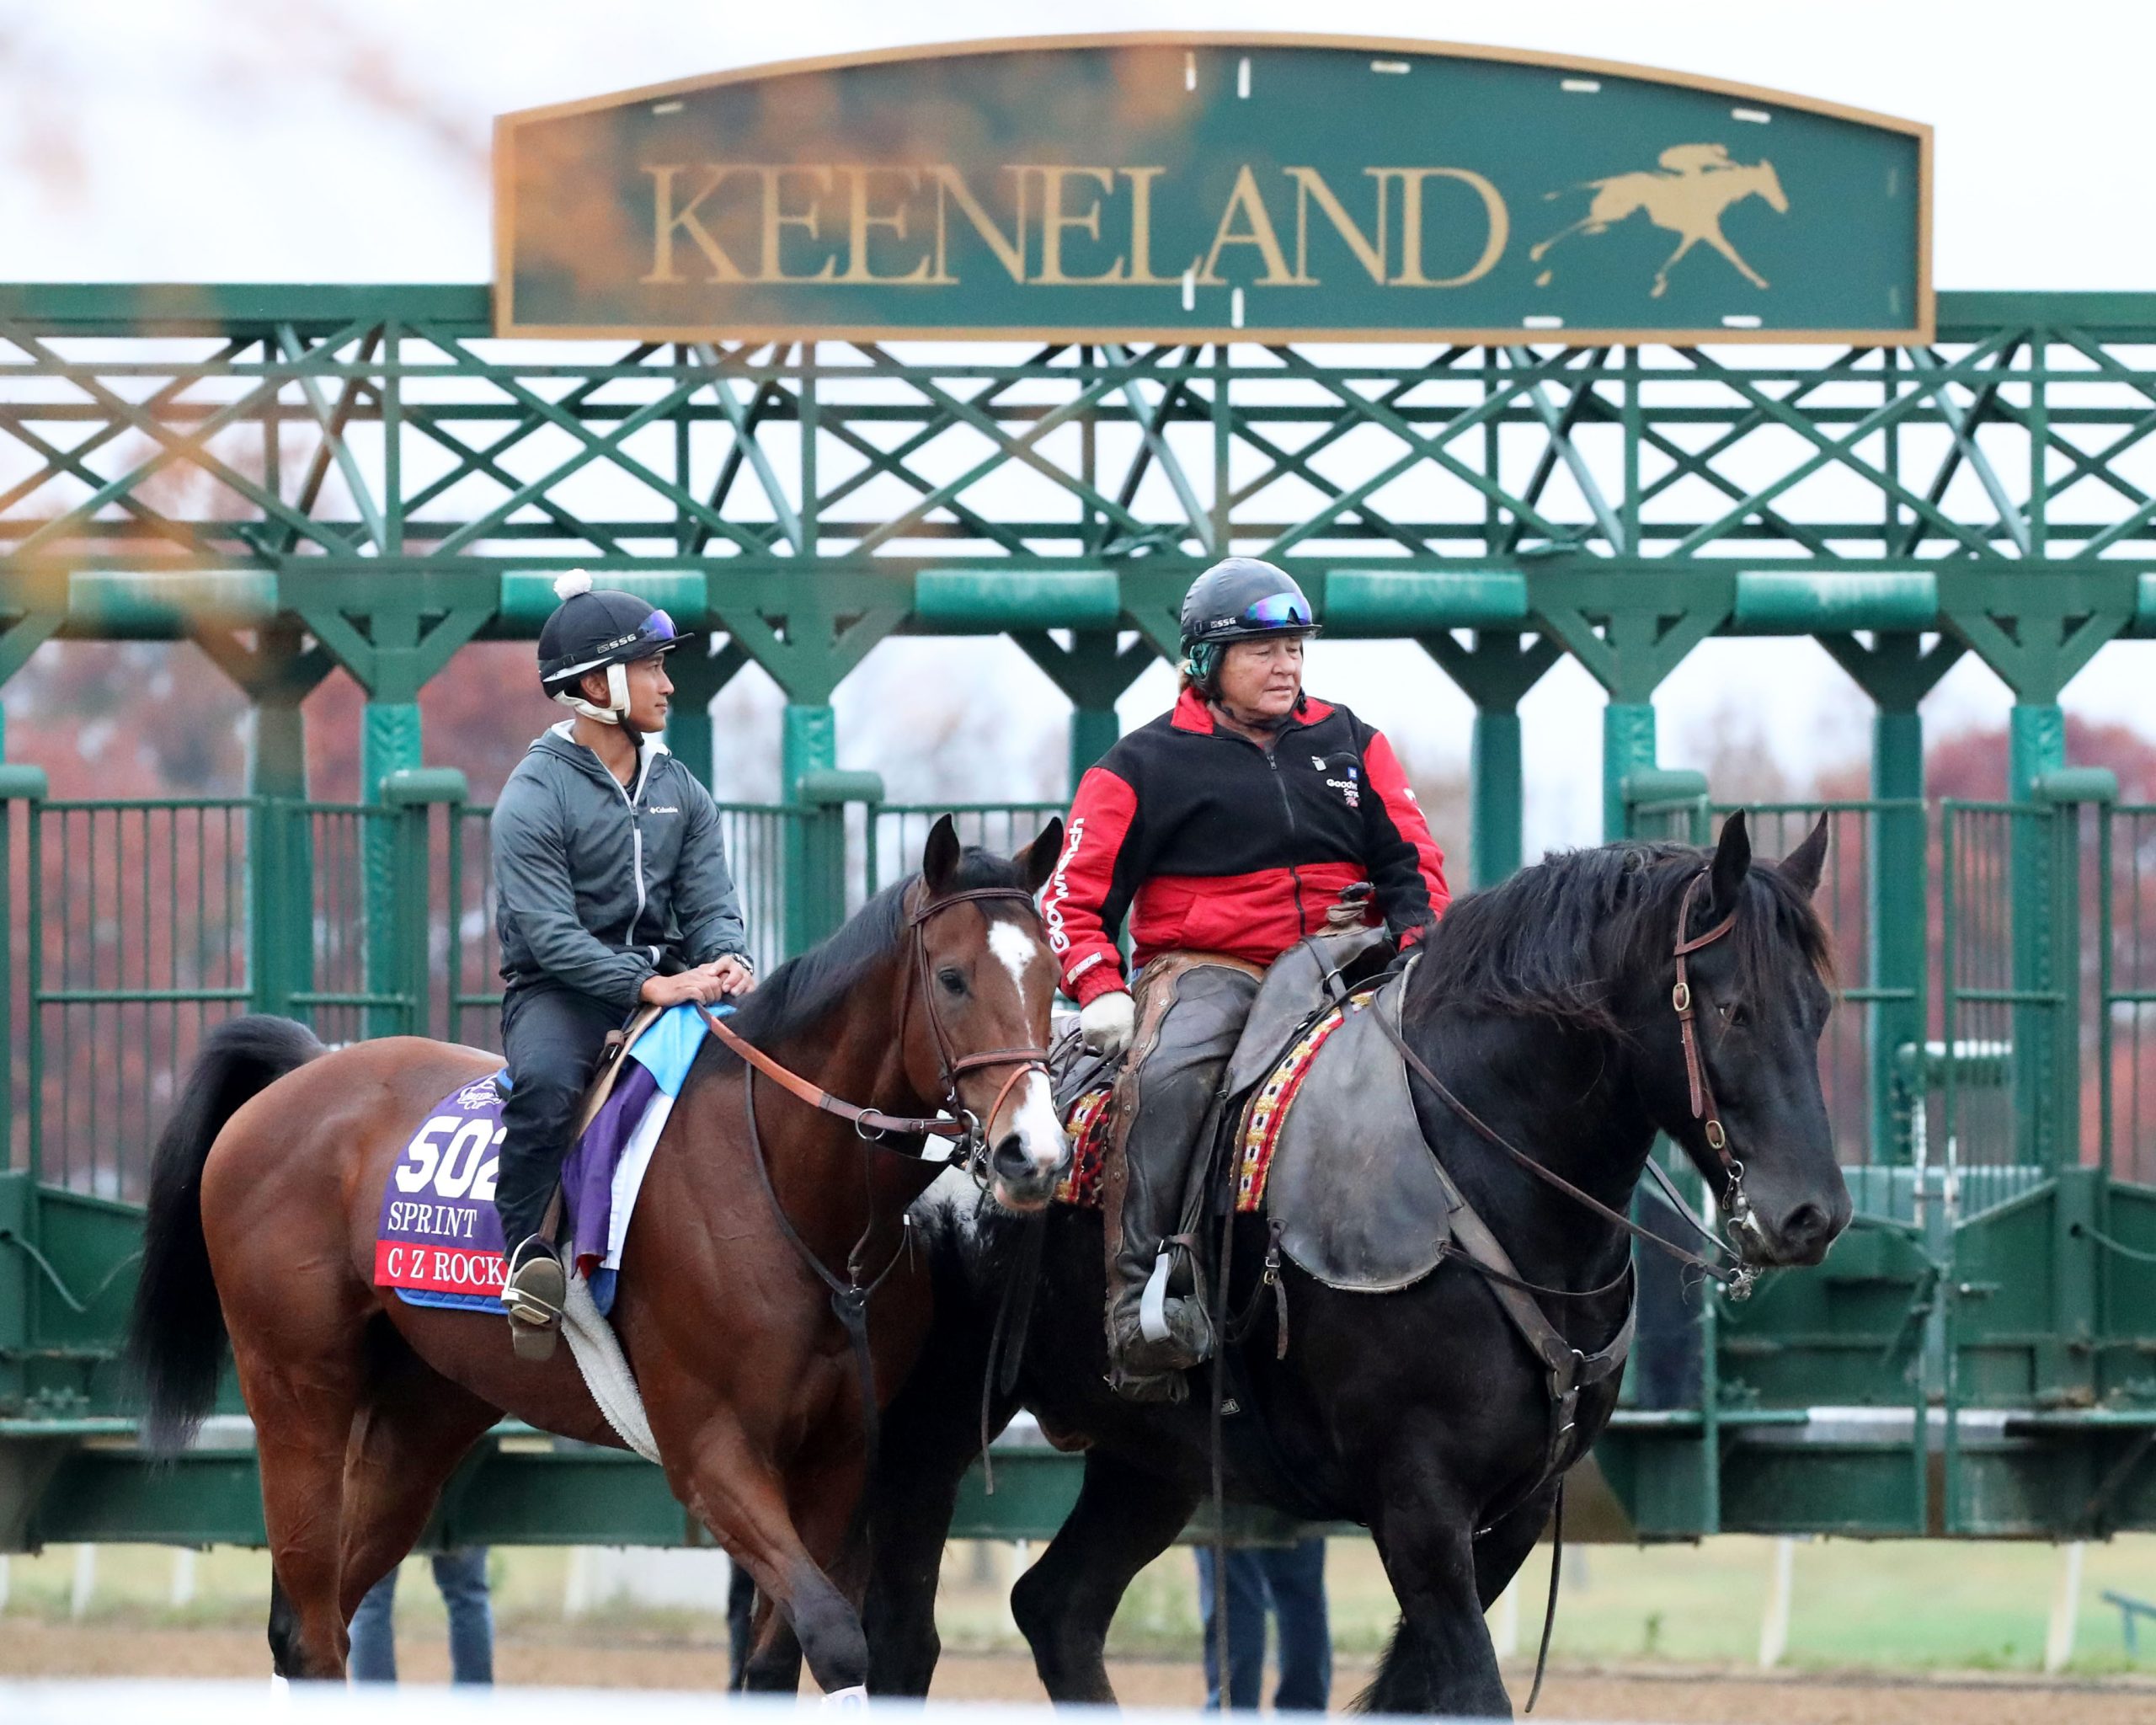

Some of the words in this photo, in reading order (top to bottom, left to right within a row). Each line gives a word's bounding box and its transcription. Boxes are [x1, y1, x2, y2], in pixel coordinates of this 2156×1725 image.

[640, 164, 1510, 287] KEENELAND
[1217, 617, 1236, 628] SSG
[609, 633, 637, 649] SSG
[387, 1201, 478, 1238] SPRINT
[387, 1247, 403, 1278] C
[410, 1249, 425, 1279] Z
